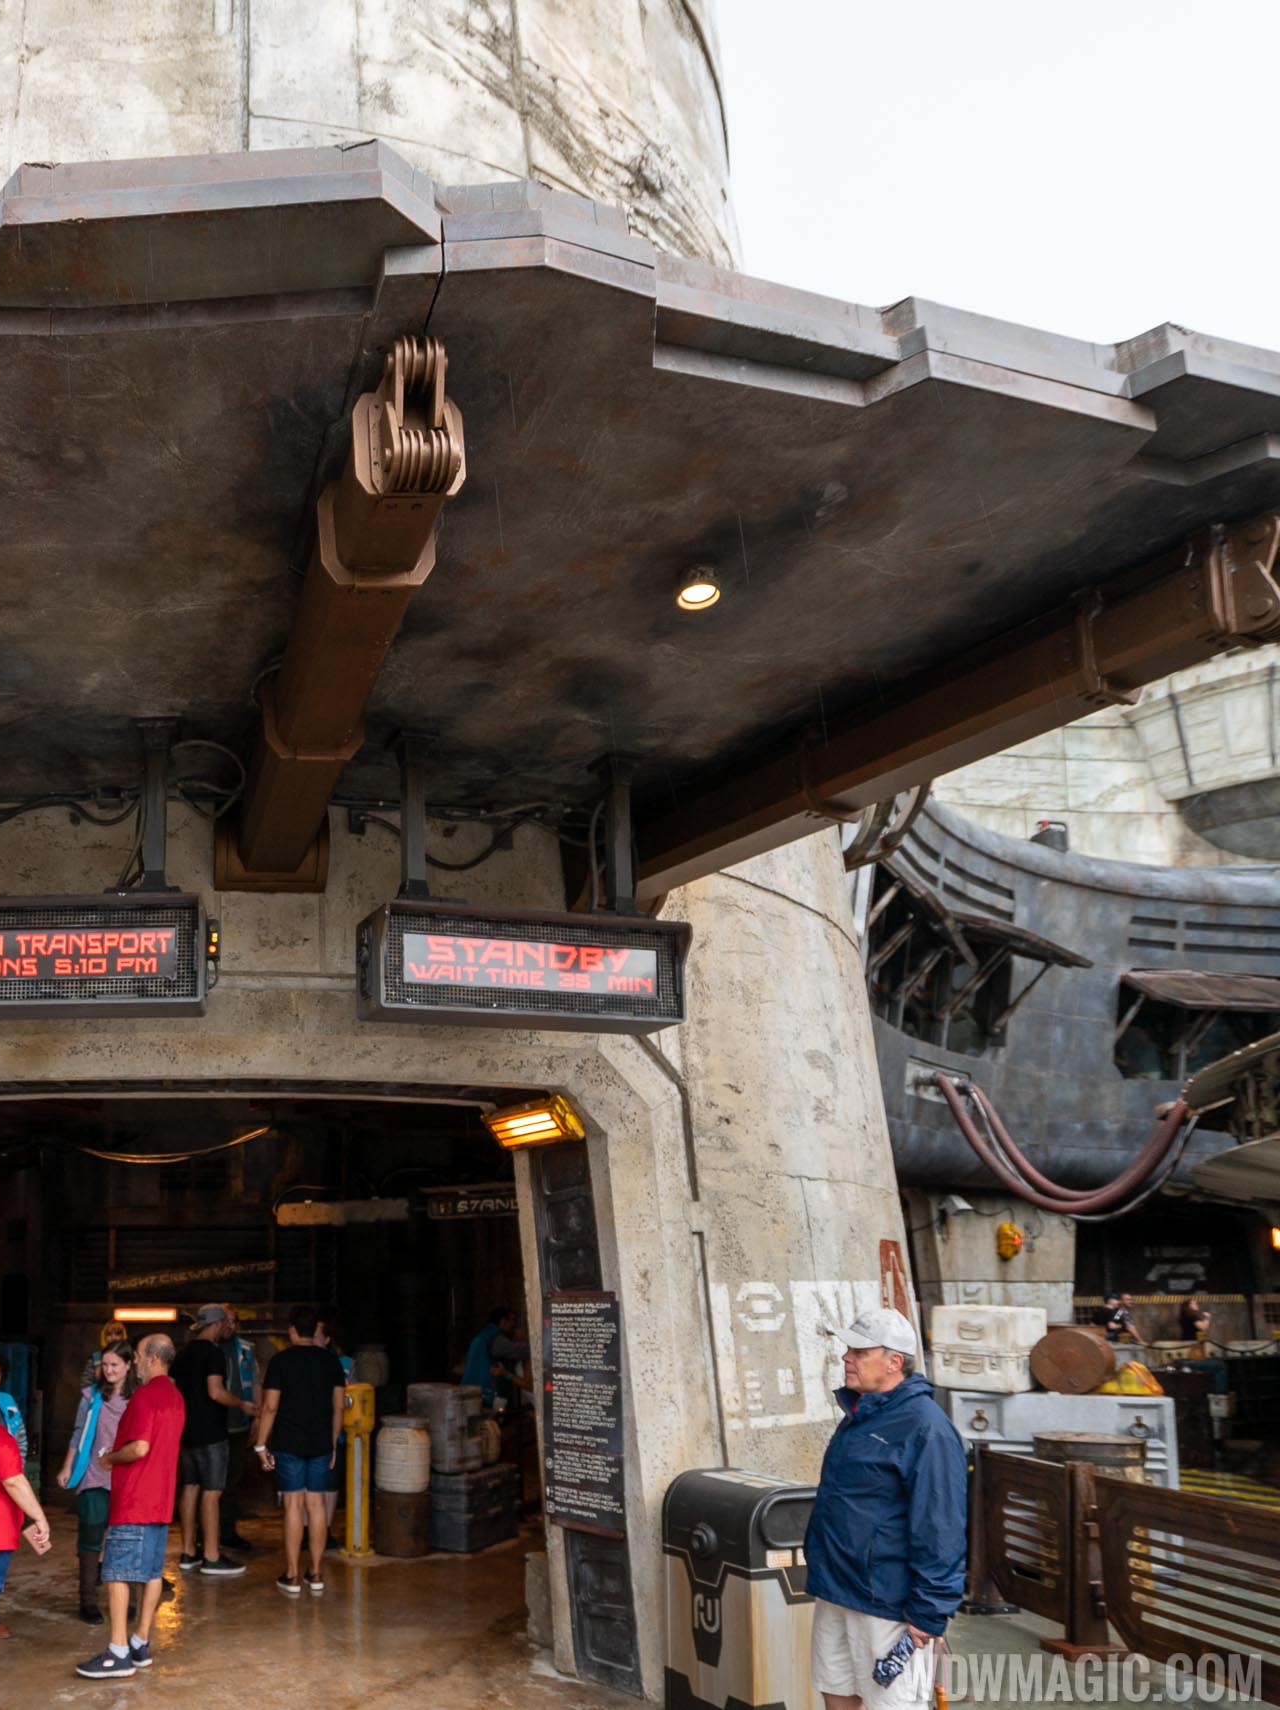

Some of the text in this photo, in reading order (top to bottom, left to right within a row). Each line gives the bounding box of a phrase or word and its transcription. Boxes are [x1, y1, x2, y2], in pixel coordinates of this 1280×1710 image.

[16, 931, 172, 955] TRANSPORT
[427, 936, 631, 972] STANDBY
[54, 958, 106, 974] 5:10
[116, 957, 158, 973] PM
[408, 962, 479, 983] WAIT
[486, 967, 544, 986] TIME
[608, 975, 653, 993] MIN
